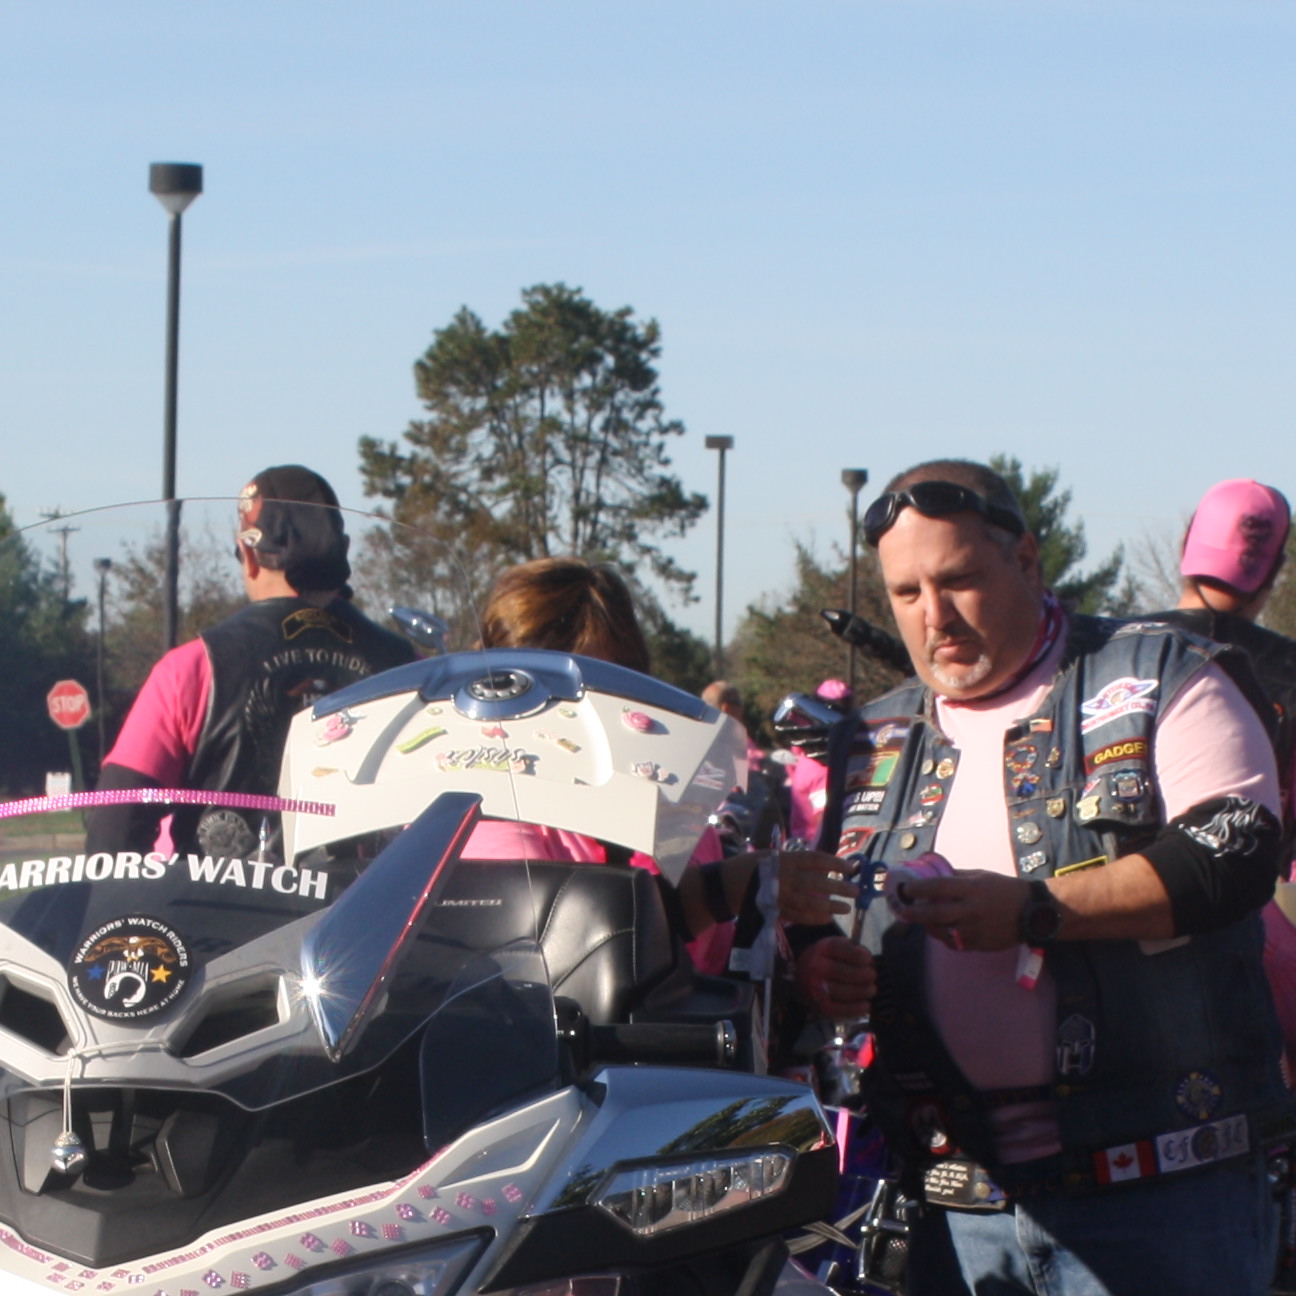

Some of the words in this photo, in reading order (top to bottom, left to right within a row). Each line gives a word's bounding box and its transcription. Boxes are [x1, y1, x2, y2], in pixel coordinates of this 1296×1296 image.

[263, 649, 302, 673] LIVE
[305, 648, 328, 663] TO
[51, 694, 85, 713] STOP
[1094, 742, 1149, 765] GADGE
[188, 854, 329, 900] WATCH
[128, 918, 168, 933] WATCH
[166, 931, 188, 967] RIDERS
